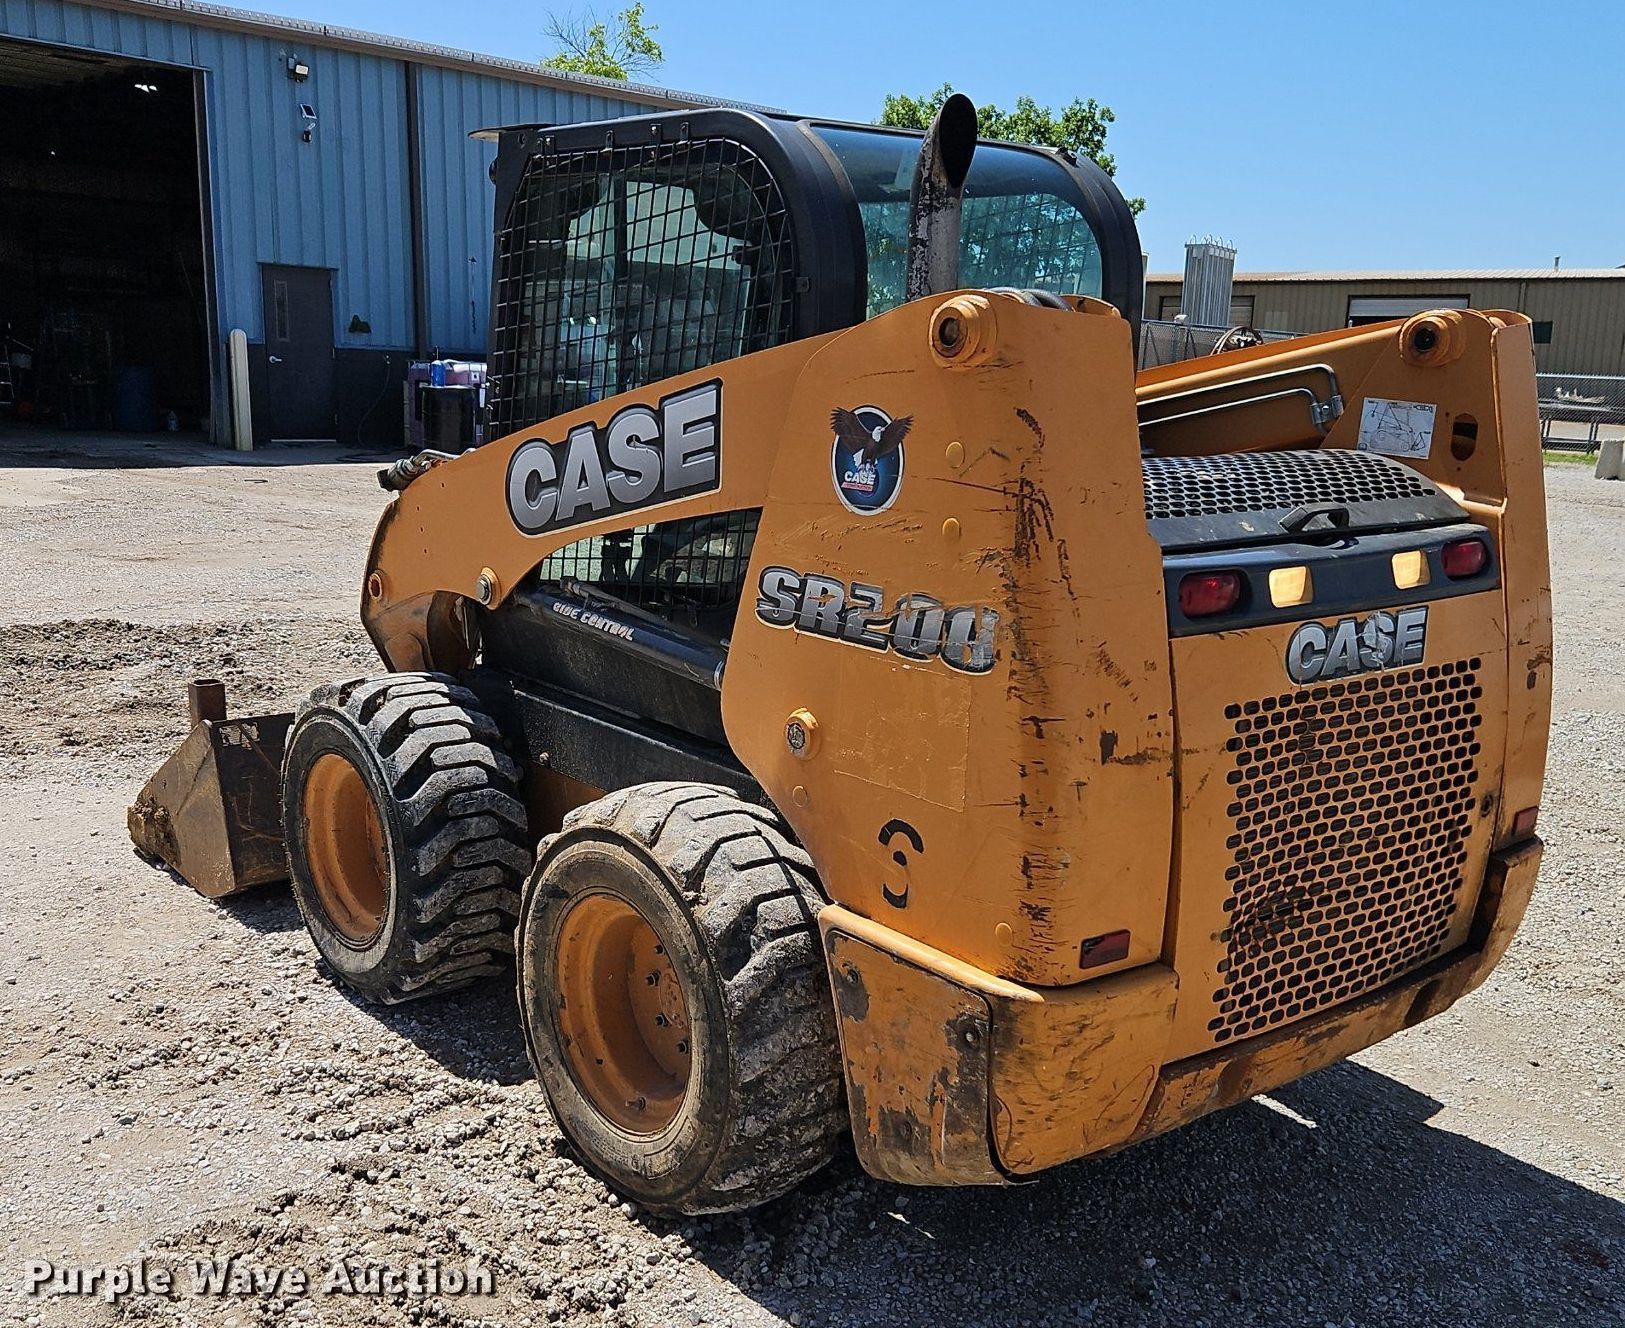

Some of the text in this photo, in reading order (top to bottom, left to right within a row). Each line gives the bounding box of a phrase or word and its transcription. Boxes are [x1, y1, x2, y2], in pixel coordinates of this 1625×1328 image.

[508, 384, 718, 529] CASE
[844, 471, 876, 485] CASE
[580, 612, 635, 641] CONTROL
[755, 568, 999, 673] SR200
[1288, 609, 1427, 683] CASE
